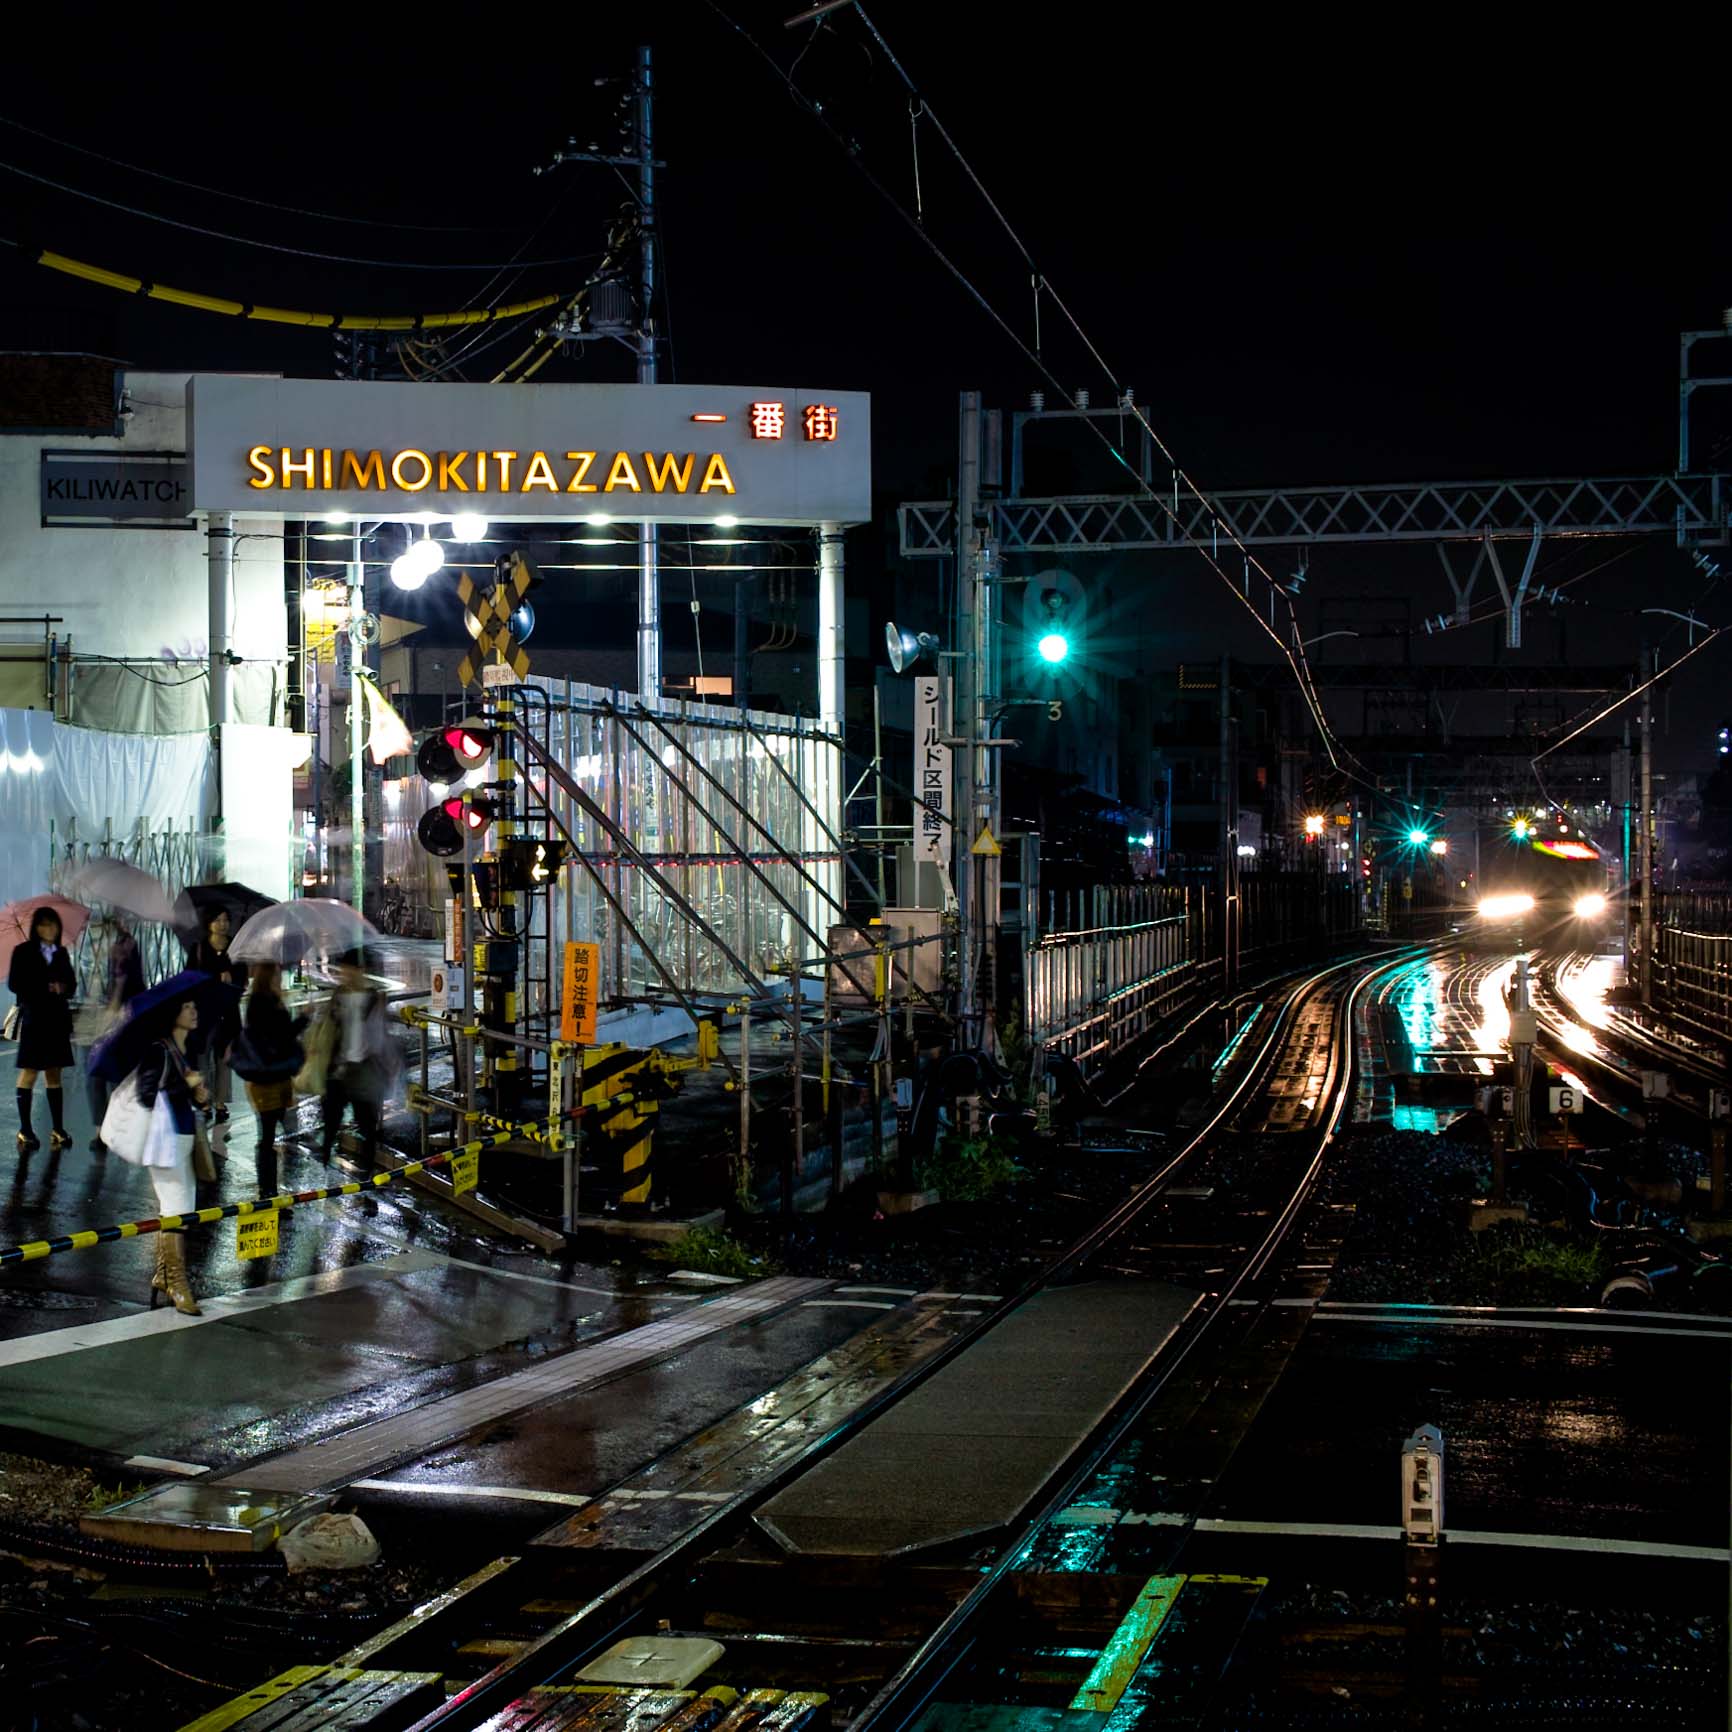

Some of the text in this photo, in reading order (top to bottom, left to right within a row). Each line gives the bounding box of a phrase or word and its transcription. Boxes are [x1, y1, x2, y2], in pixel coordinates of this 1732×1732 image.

[691, 402, 839, 440] 一番街
[247, 445, 737, 495] SHIMOKITAZAWA
[1047, 700, 1062, 721] 3
[1559, 1089, 1574, 1109] 6
